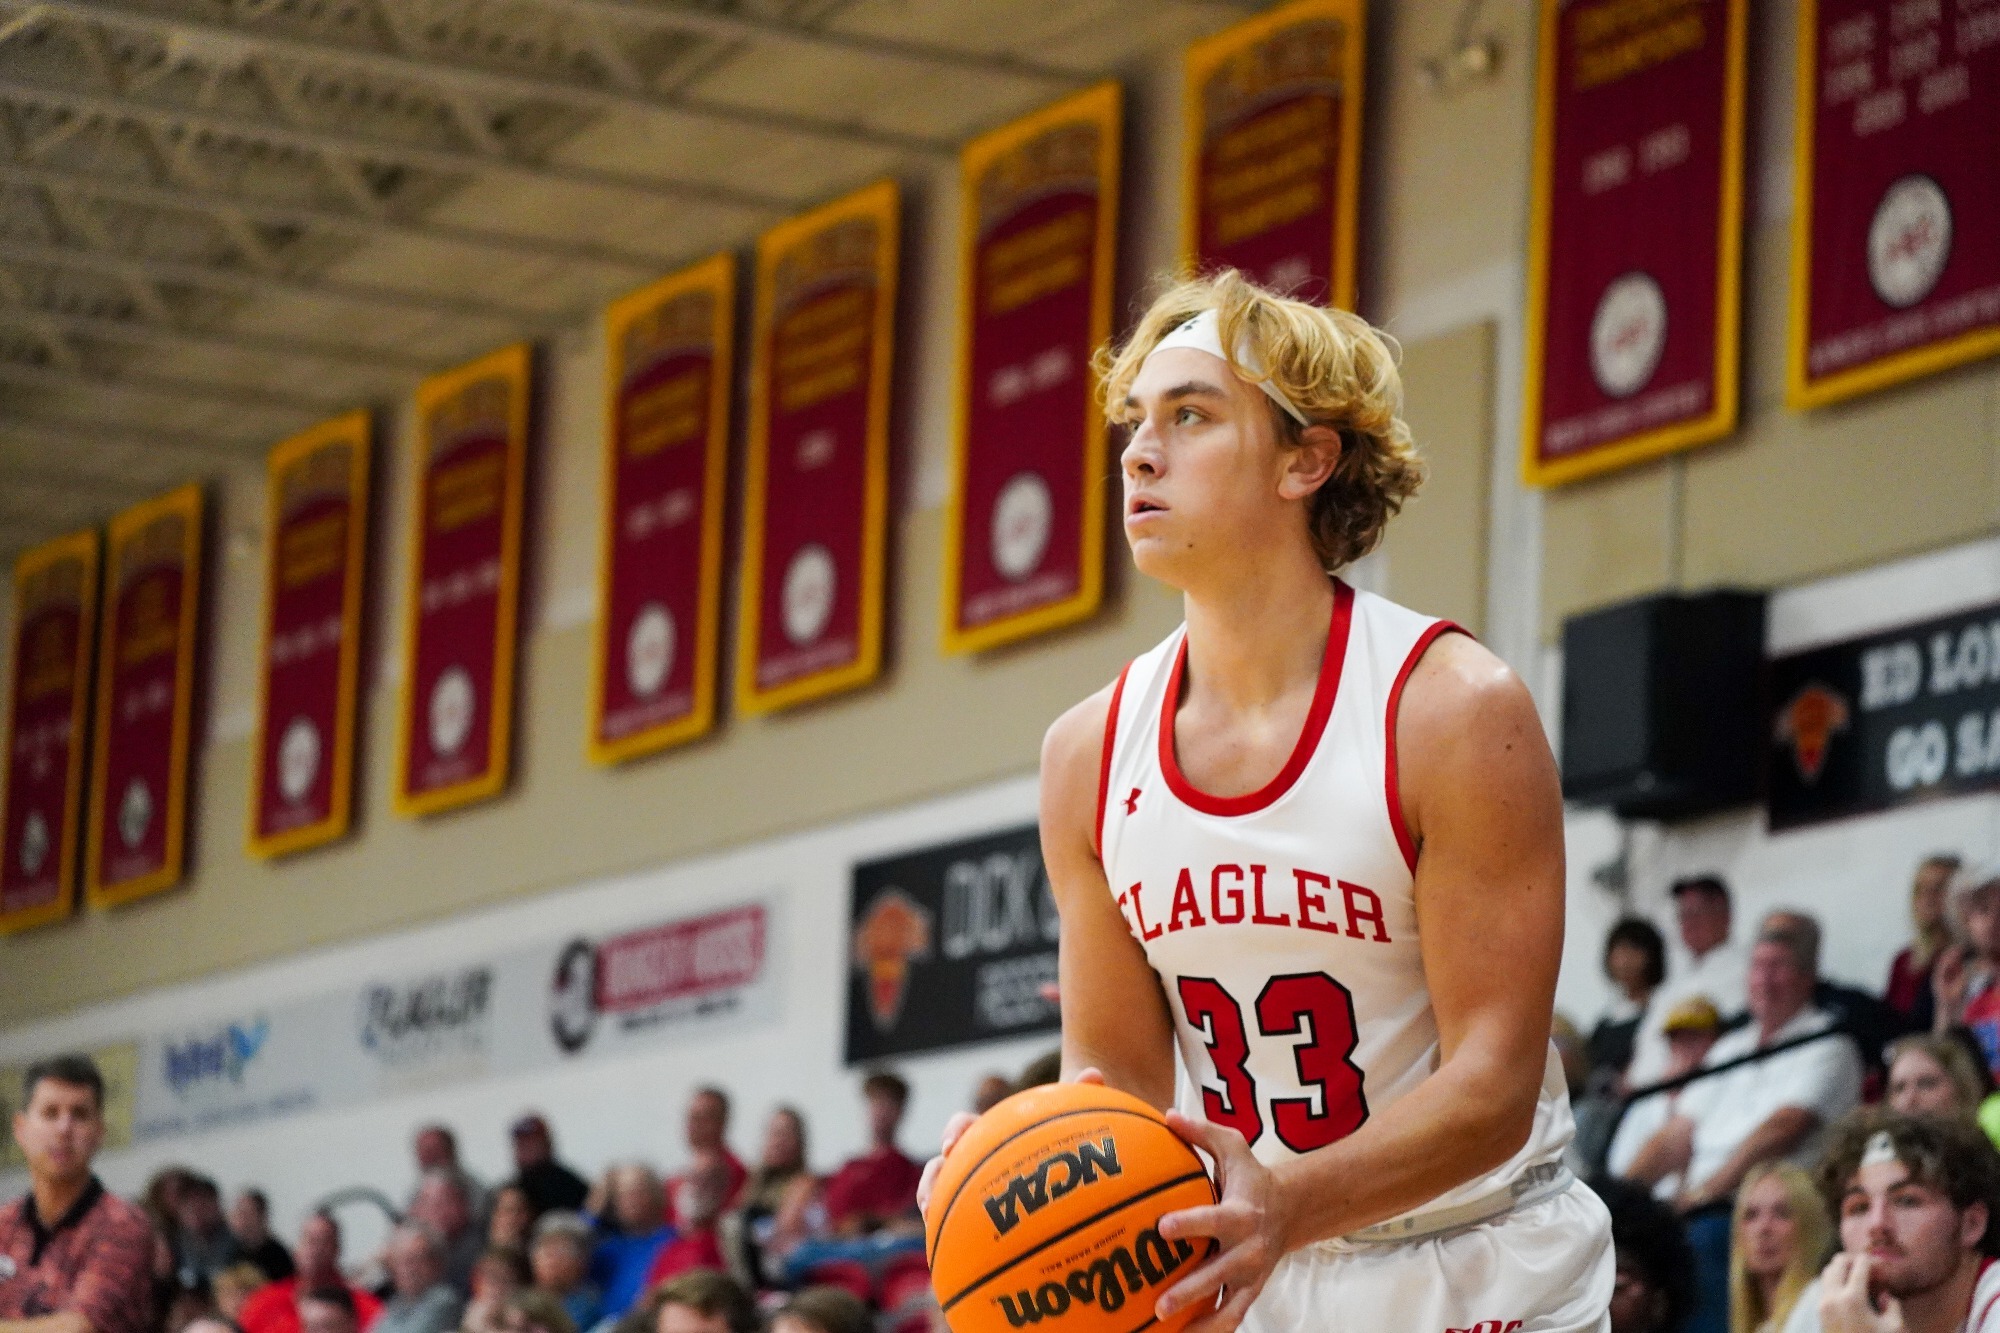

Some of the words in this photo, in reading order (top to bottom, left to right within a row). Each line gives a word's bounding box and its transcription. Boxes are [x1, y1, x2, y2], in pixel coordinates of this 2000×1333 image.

[1862, 644, 1921, 710] ED
[1887, 722, 1947, 789] GO
[1177, 971, 1370, 1154] 33
[984, 1136, 1122, 1236] NCAA
[997, 1221, 1194, 1328] Wilson
